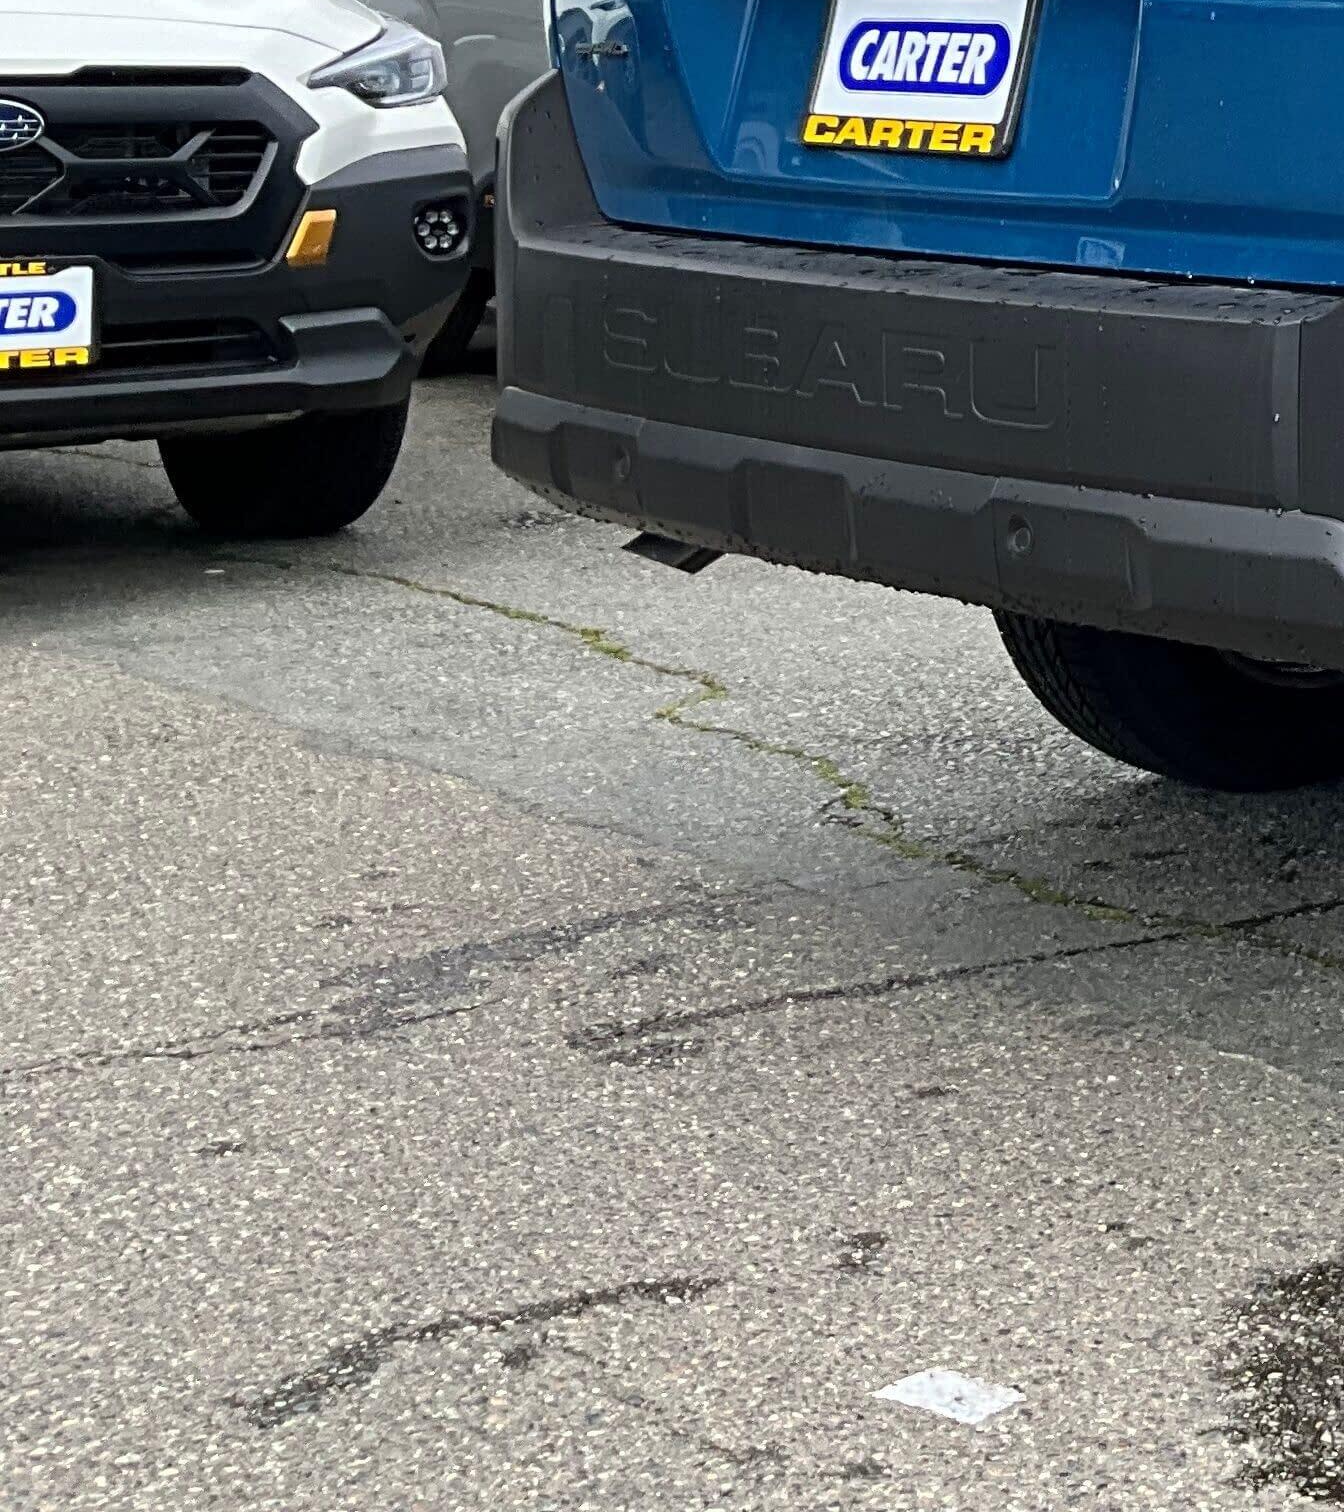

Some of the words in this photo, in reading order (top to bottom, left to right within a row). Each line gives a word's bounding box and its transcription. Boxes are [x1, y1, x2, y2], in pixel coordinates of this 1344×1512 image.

[849, 28, 998, 85] CARTER
[802, 114, 996, 153] CARTER
[603, 305, 1057, 431] SUBARU
